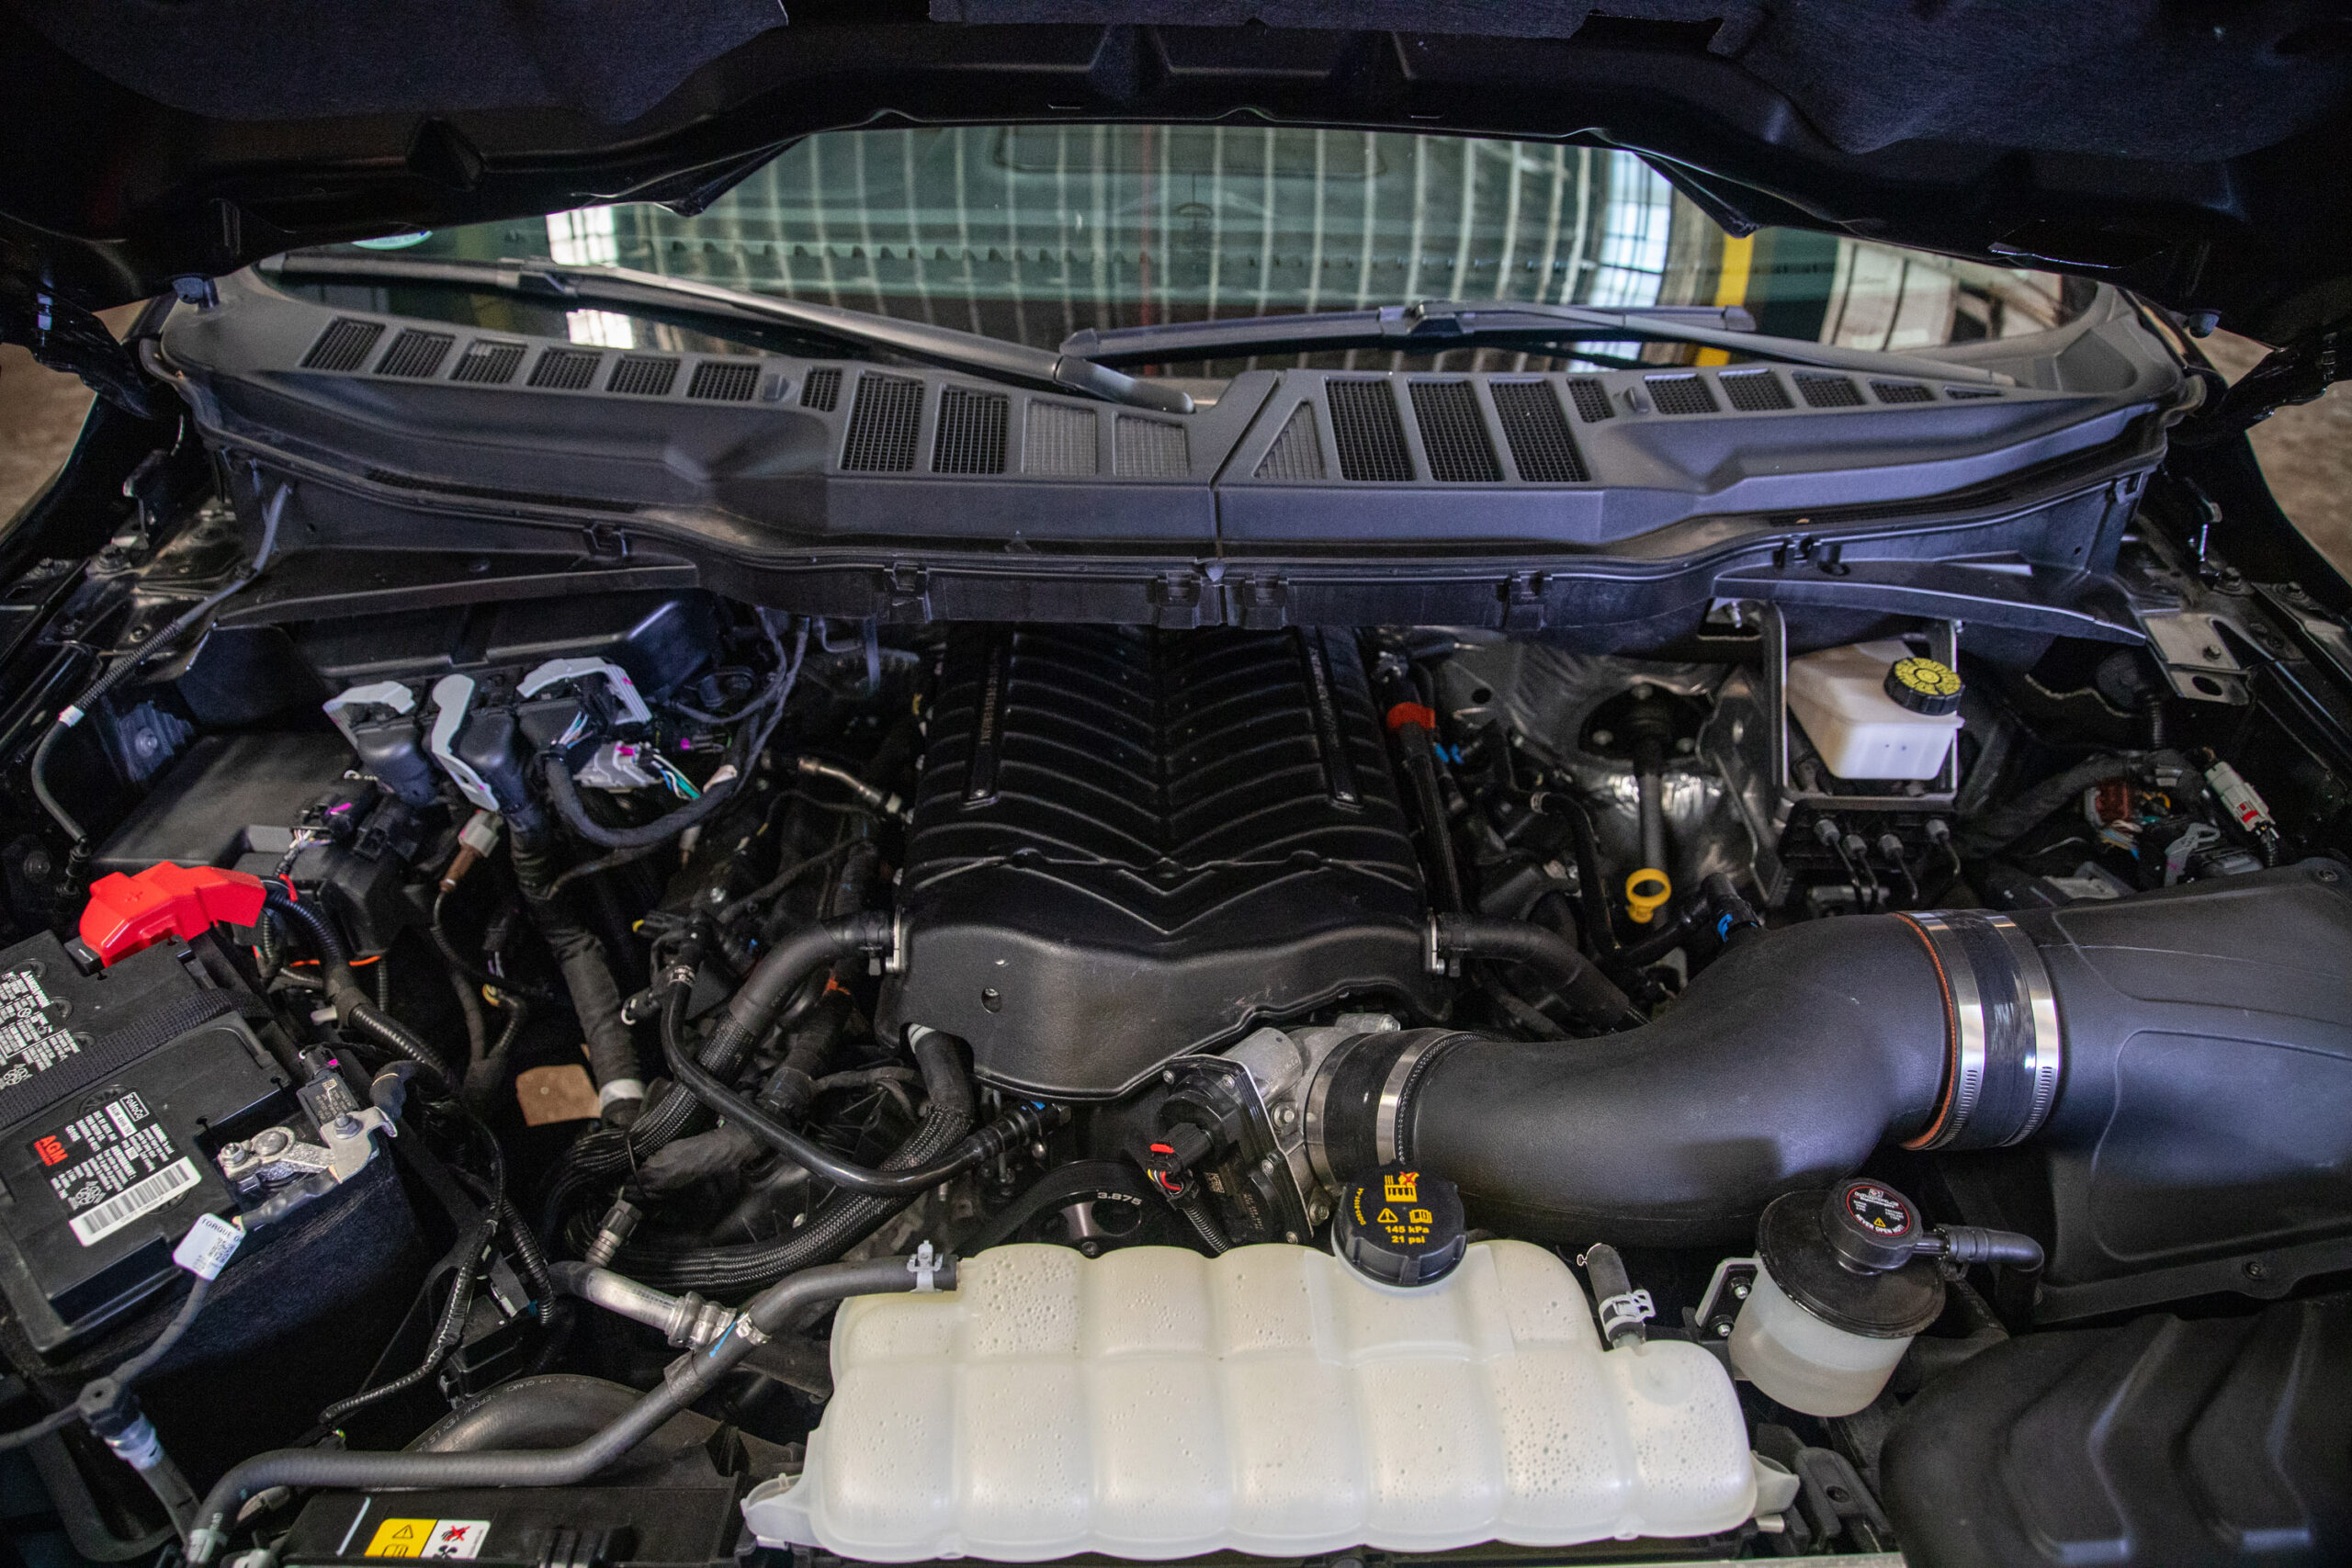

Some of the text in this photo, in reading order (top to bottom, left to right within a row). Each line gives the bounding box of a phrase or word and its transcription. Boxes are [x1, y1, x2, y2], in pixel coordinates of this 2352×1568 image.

[122, 1094, 145, 1119] FoMoCo
[40, 1134, 68, 1163] AGM
[1097, 1192, 1142, 1205] 3.875
[200, 1218, 232, 1238] TORQUE
[1855, 1213, 1874, 1230] NEVER
[1408, 1235, 1425, 1245] psi
